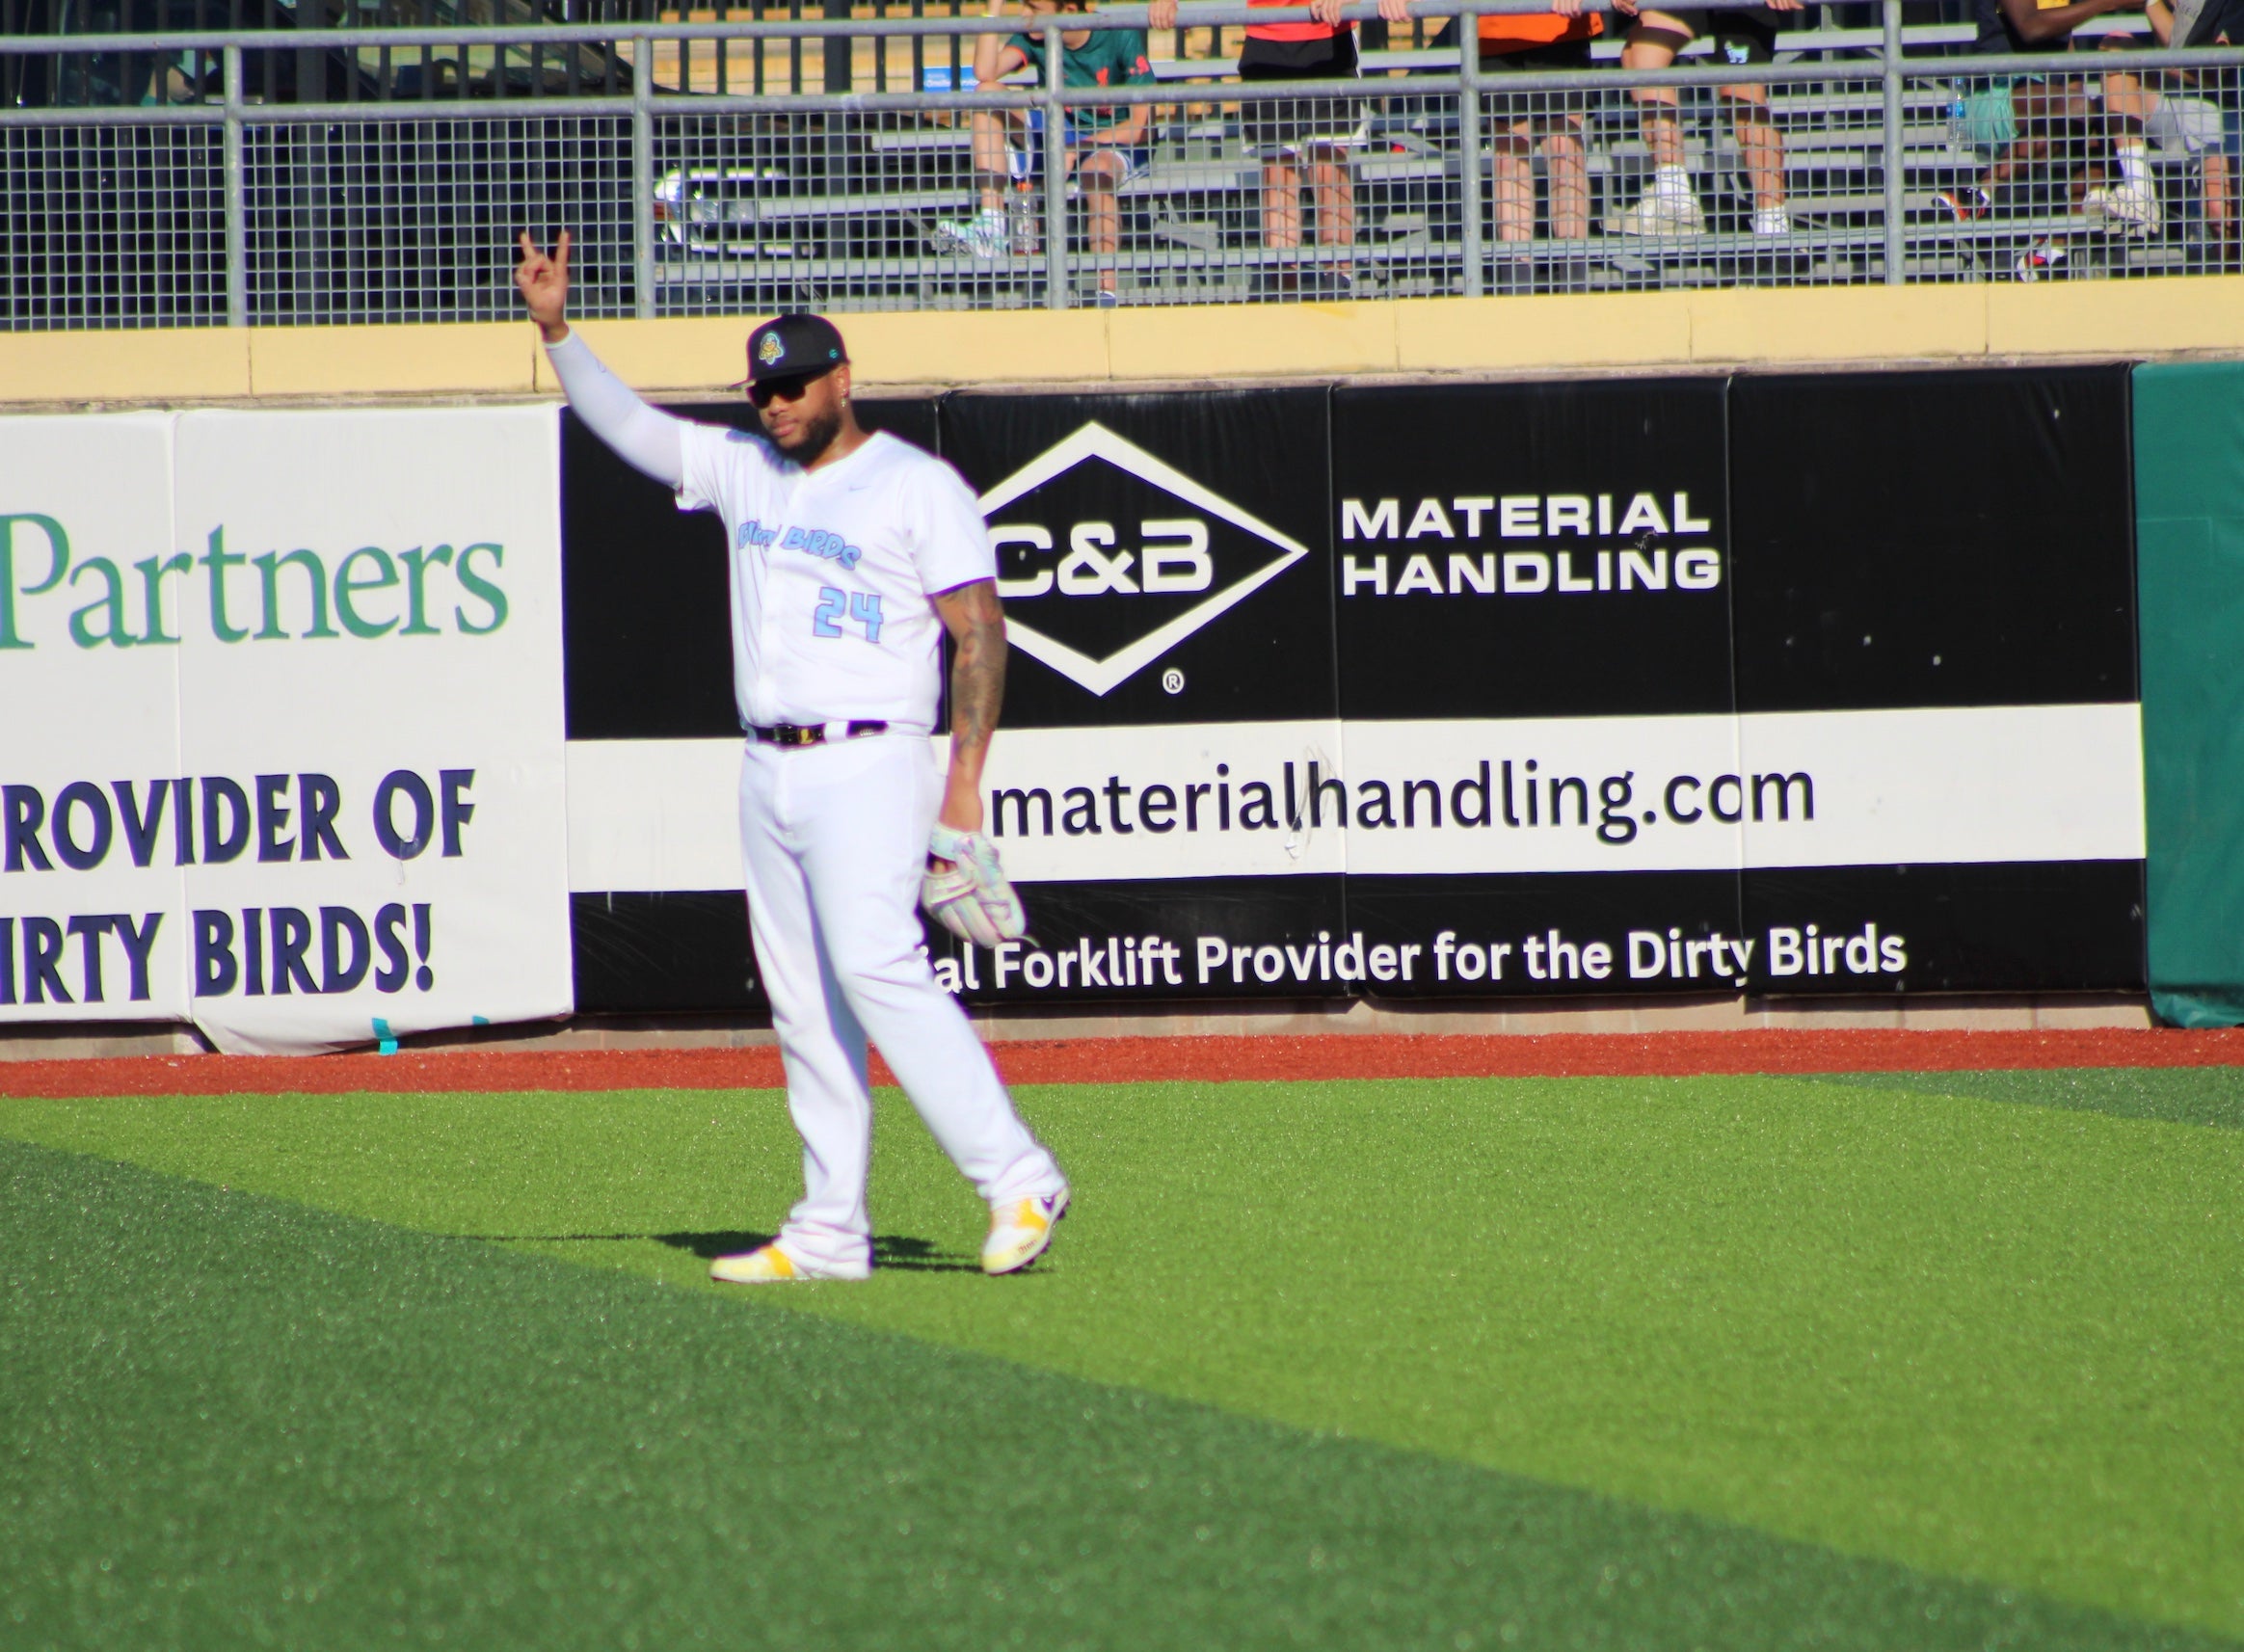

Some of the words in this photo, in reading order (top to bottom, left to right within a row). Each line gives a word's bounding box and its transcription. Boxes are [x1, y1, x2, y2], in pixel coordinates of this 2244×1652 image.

[780, 526, 863, 571] BIRDS
[1342, 492, 1711, 540] MATERIAL
[0, 513, 508, 650] Partners
[988, 519, 1213, 598] C&B
[1343, 548, 1721, 596] HANDLING
[813, 586, 884, 644] 24
[1, 773, 350, 872] ROVIDER
[372, 768, 475, 861] OF
[194, 902, 433, 998] BIRDS!
[995, 936, 1183, 990] Forklift
[1197, 930, 1421, 983] Provider
[1433, 930, 1511, 980] for
[1523, 928, 1613, 979] the
[1628, 928, 1755, 988] Dirty
[1769, 923, 1908, 976] Birds
